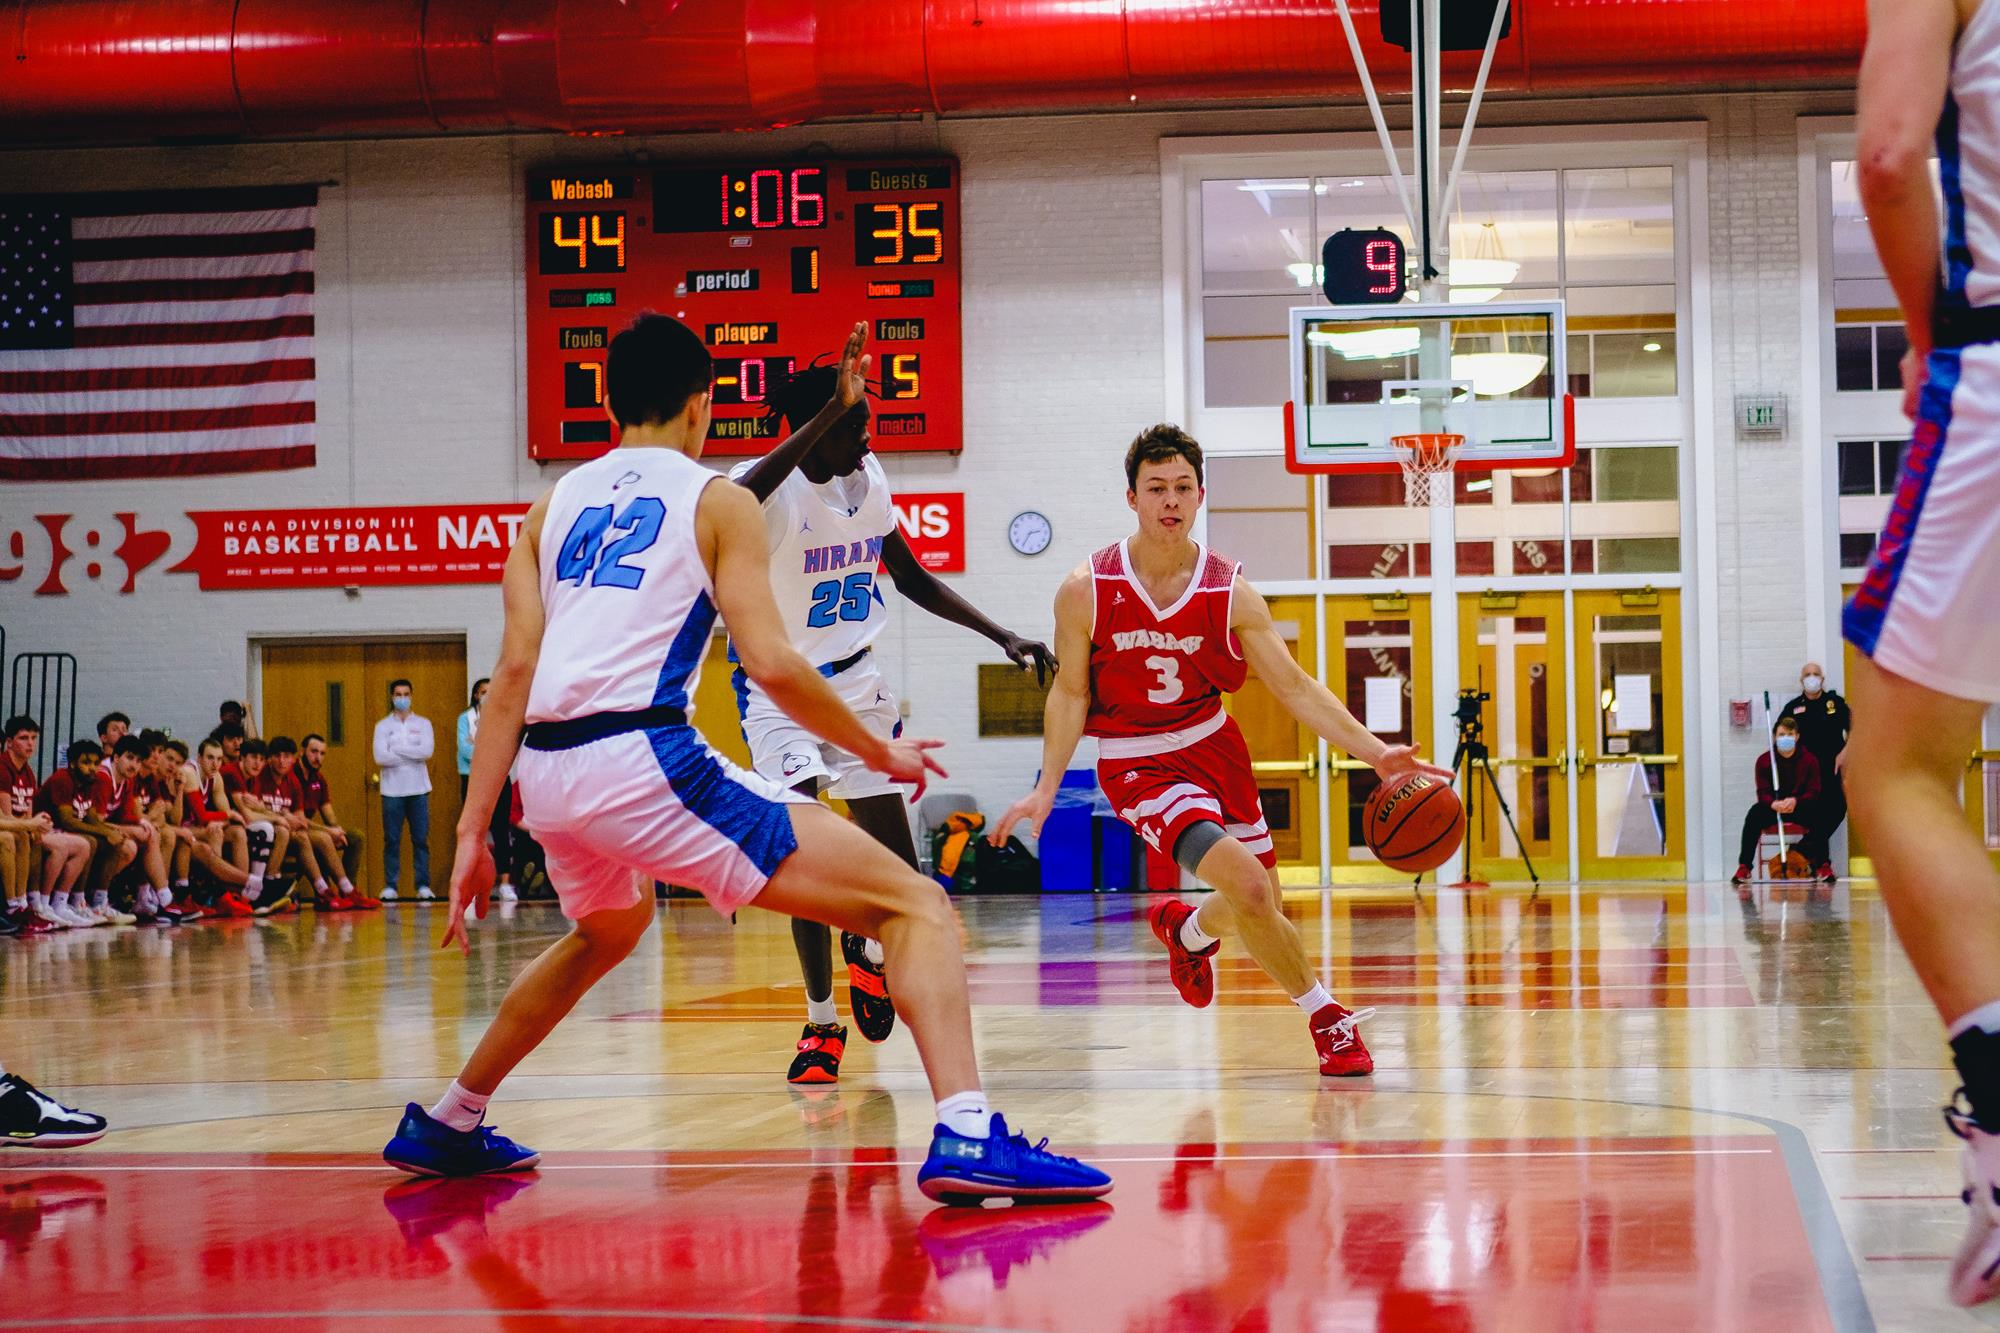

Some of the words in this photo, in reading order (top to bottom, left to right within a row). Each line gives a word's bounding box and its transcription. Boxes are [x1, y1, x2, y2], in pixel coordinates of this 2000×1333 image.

[551, 179, 614, 200] Wabash
[721, 168, 824, 228] 1:06
[870, 171, 928, 190] Guests
[553, 214, 625, 268] 44
[872, 203, 942, 264] 35
[696, 269, 750, 293] period
[810, 250, 819, 290] 1
[1366, 241, 1397, 294] 9
[564, 330, 602, 349] fouls
[714, 323, 769, 345] player
[880, 321, 920, 340] fouls
[579, 362, 602, 404] 7
[893, 354, 919, 398] 5
[879, 415, 922, 434] match
[223, 520, 276, 533] NCAA
[287, 517, 380, 532] DIVISION
[391, 516, 414, 529] III
[224, 532, 418, 555] BASKETBALL
[556, 497, 667, 591] 42
[807, 572, 872, 628] 25
[1144, 655, 1184, 704] 3
[1378, 774, 1436, 823] Wilson
